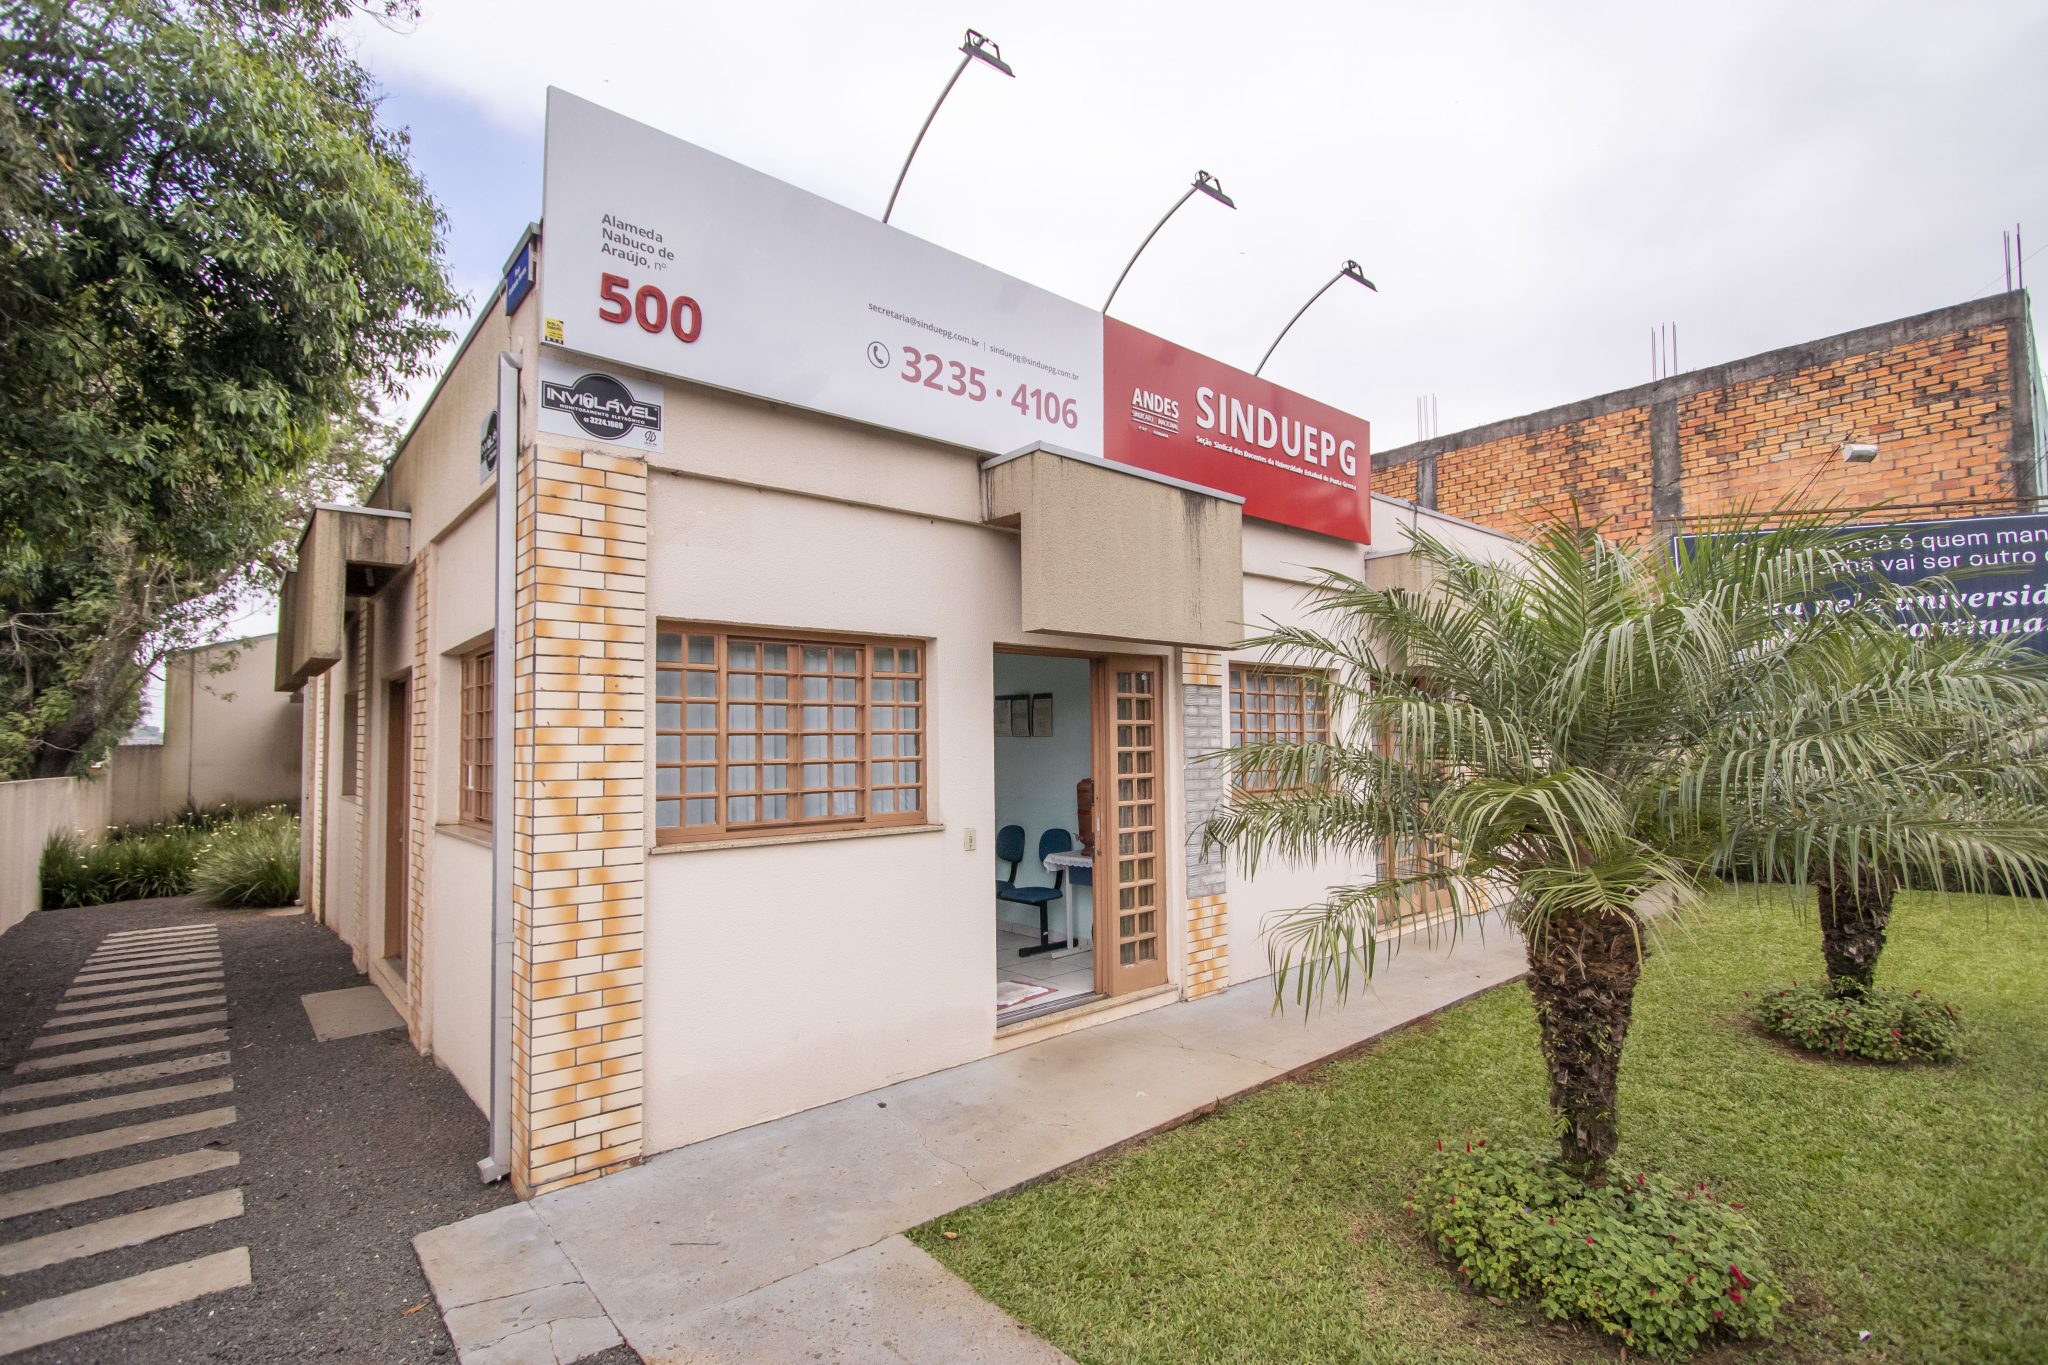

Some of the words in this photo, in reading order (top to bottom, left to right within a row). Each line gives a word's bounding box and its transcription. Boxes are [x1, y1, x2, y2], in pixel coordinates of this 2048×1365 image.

[602, 214, 662, 243] Alameda
[602, 228, 655, 254] Nabuco
[658, 247, 675, 261] de
[601, 243, 650, 269] Araújo,
[599, 272, 702, 343] 500
[868, 302, 980, 347] secretaria@sinduepg.com.br
[989, 344, 1080, 381] sinduepg@sinduepg.com.br
[546, 387, 657, 420] INVIOLÁVEL
[901, 346, 986, 401] 3235
[1011, 383, 1078, 429] 4106
[1132, 388, 1179, 419] ANDES
[560, 404, 609, 417] MONITORAMENTO
[611, 415, 645, 425] ELETRÔNICO
[1196, 386, 1356, 476] SINDUEPG
[1921, 532, 1988, 551] quem
[1881, 554, 1915, 571] vai
[1923, 555, 1960, 570] ser
[1970, 550, 2036, 566] outro
